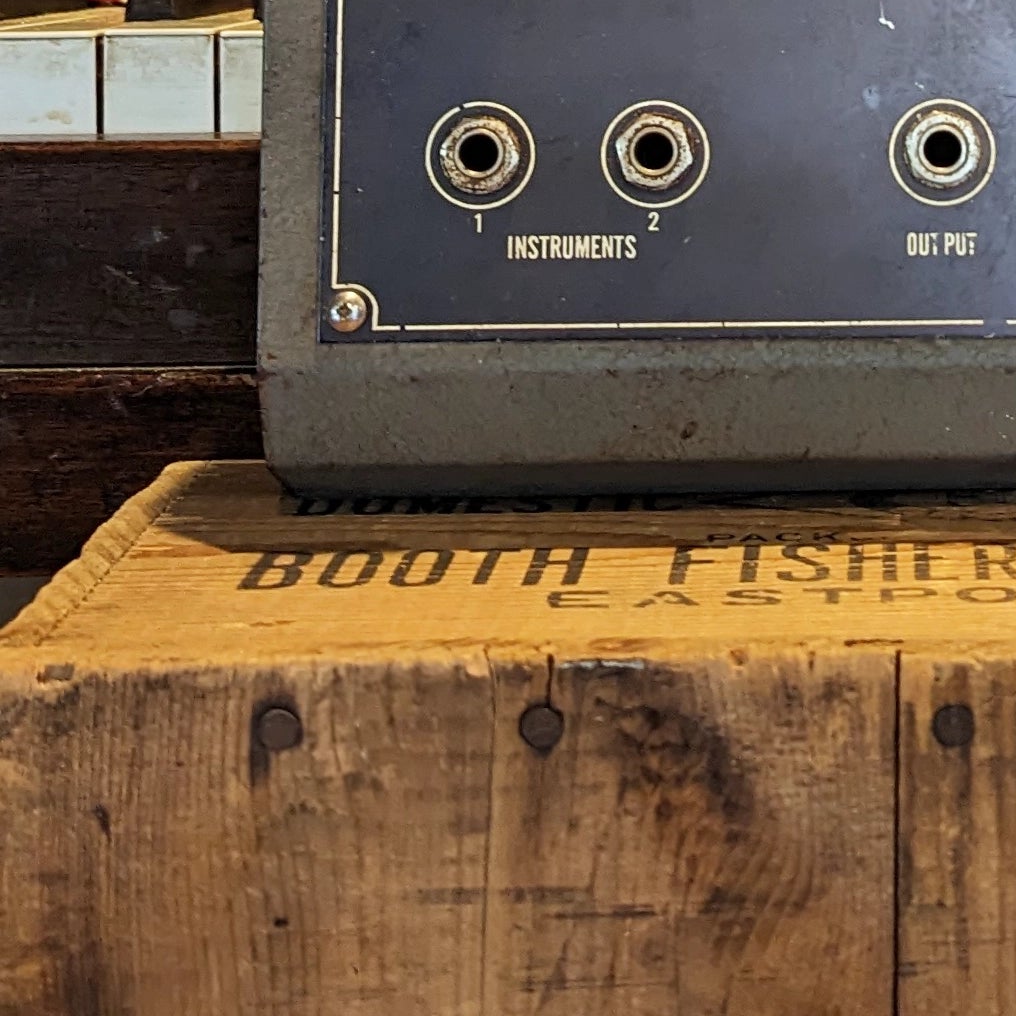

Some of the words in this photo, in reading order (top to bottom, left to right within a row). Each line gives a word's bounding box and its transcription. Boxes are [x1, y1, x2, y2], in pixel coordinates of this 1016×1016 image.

[474, 212, 483, 233] 1
[648, 211, 659, 231] 2
[507, 235, 637, 259] INSTRUMENTS
[237, 546, 591, 590] BOOTH
